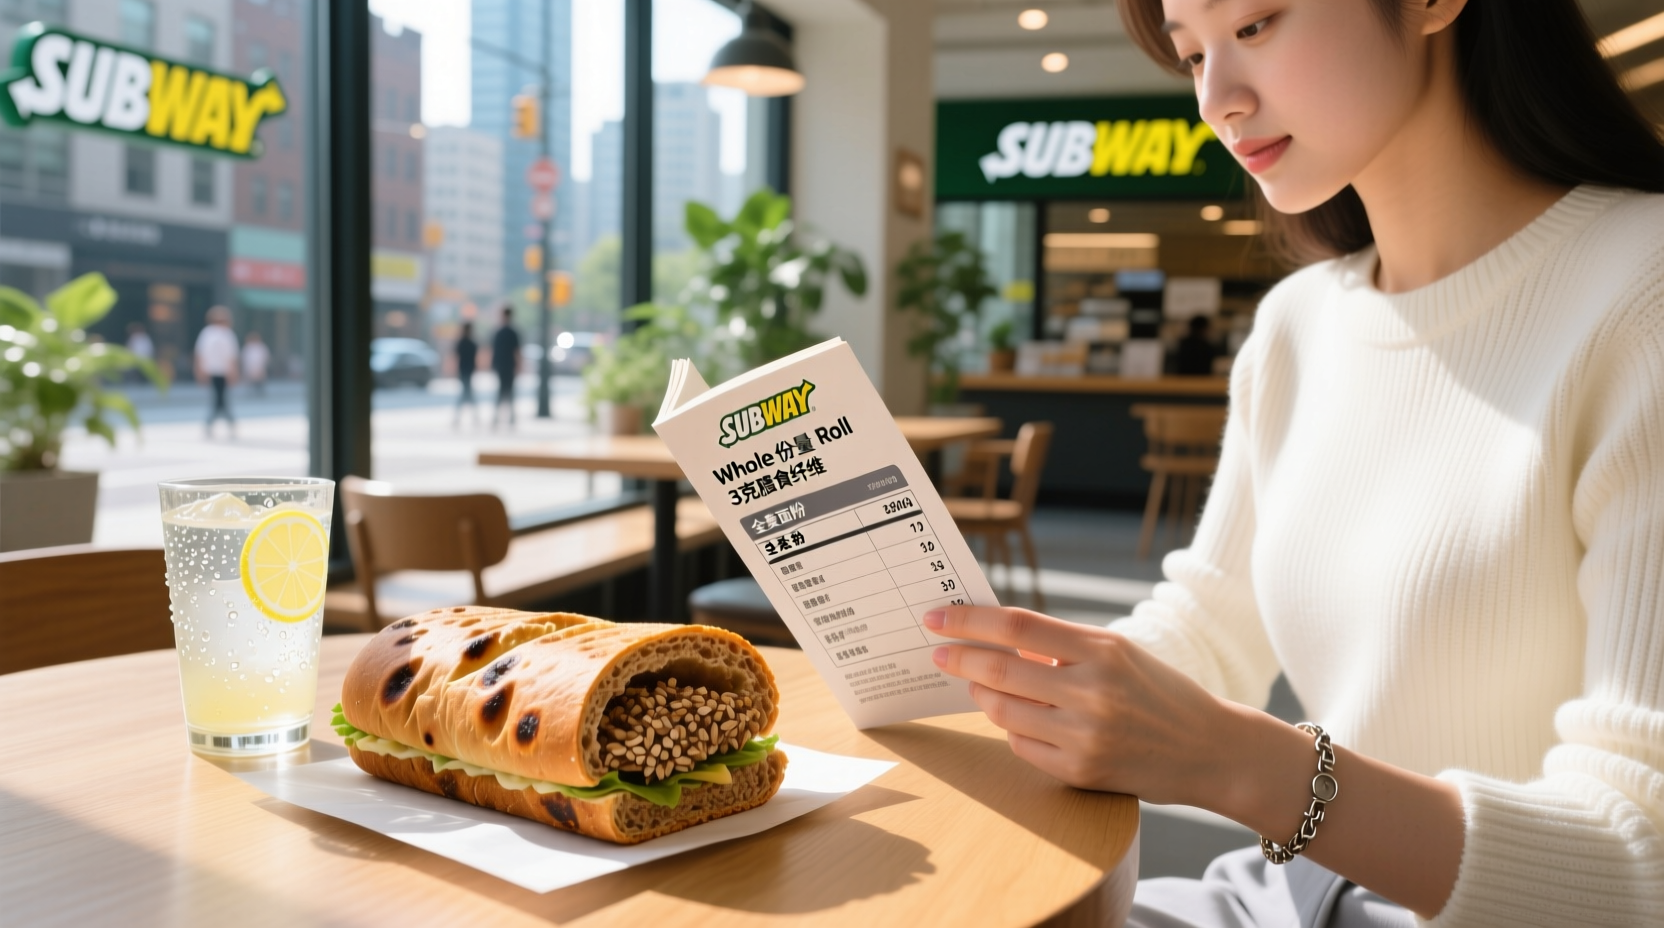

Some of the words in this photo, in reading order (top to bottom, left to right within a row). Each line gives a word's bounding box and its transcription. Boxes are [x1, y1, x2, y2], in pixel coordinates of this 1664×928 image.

[8, 33, 286, 154] SUBWAY
[979, 119, 1216, 184] SUBWAY
[719, 379, 816, 448] SUBWAY
[712, 452, 775, 485] Whole
[815, 416, 853, 445] Roll
